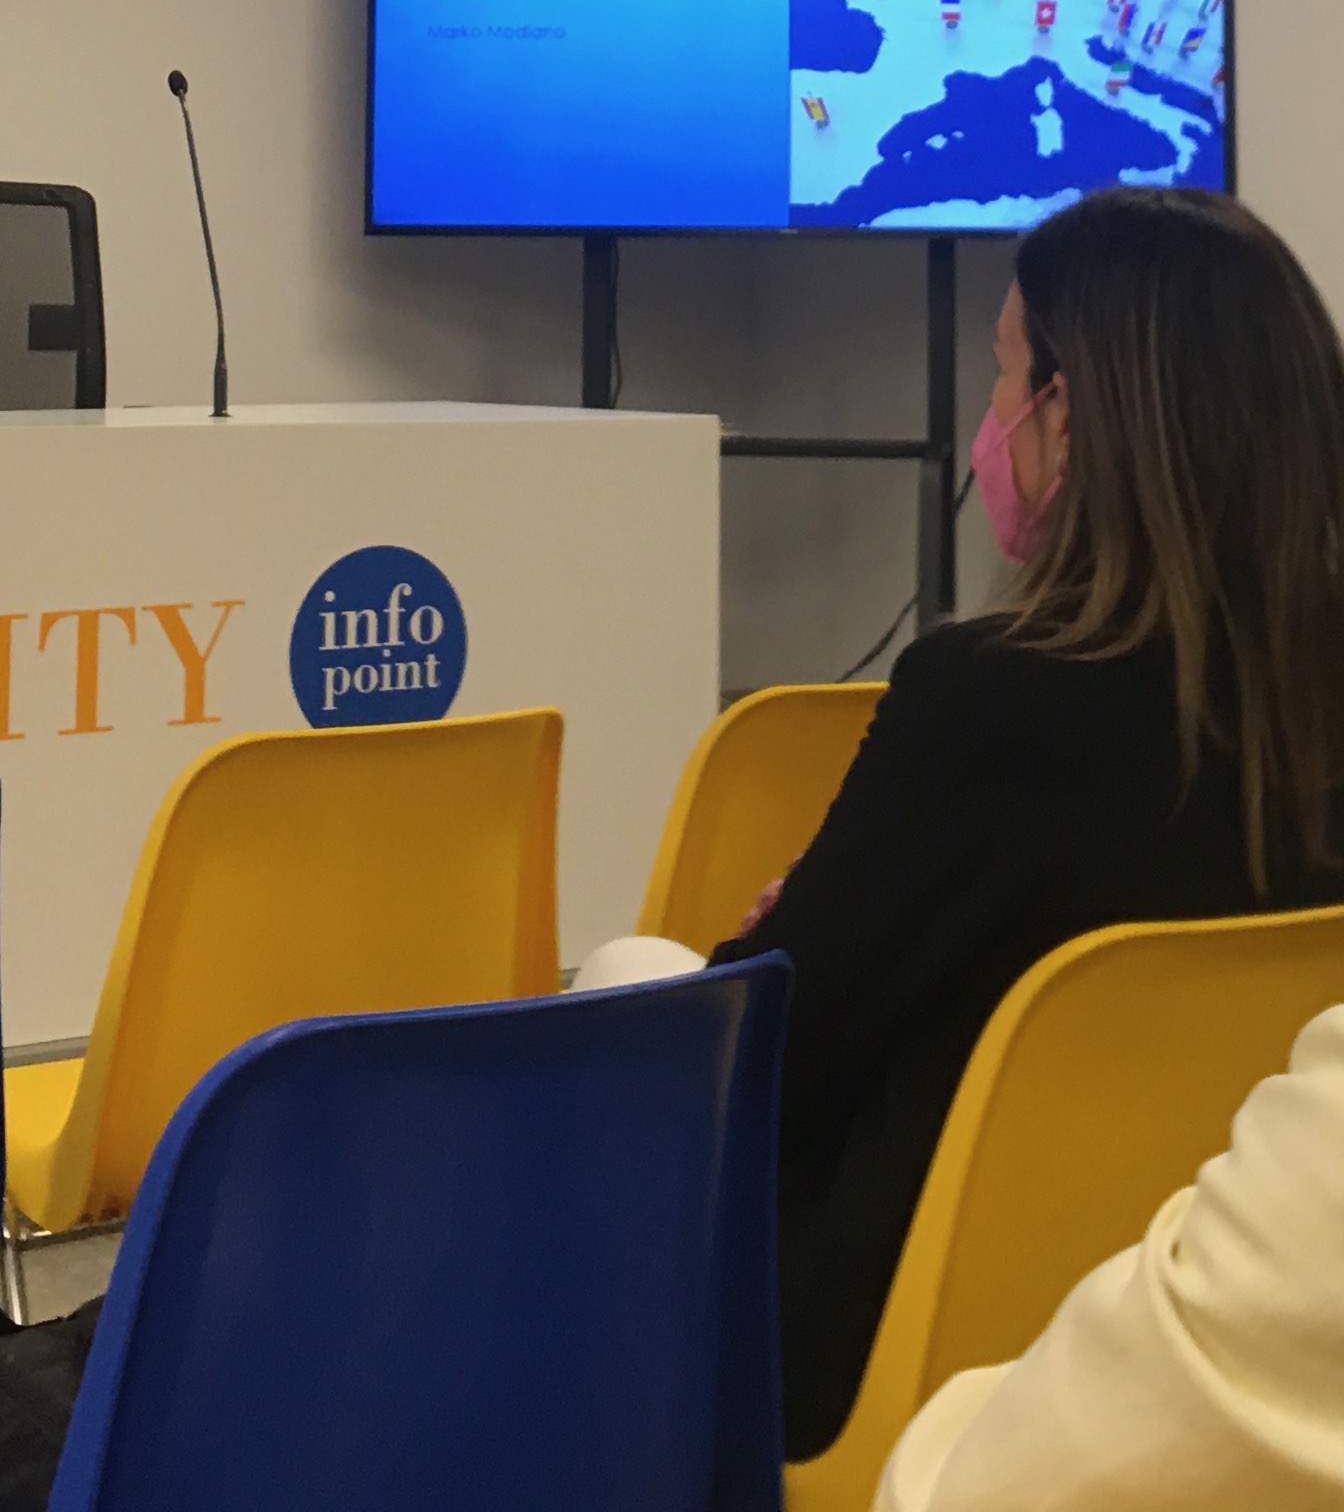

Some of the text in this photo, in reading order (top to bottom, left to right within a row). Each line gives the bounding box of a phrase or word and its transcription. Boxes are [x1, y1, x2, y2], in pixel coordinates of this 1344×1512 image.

[427, 24, 483, 39] Marko
[318, 582, 445, 651] info
[320, 648, 442, 712] point
